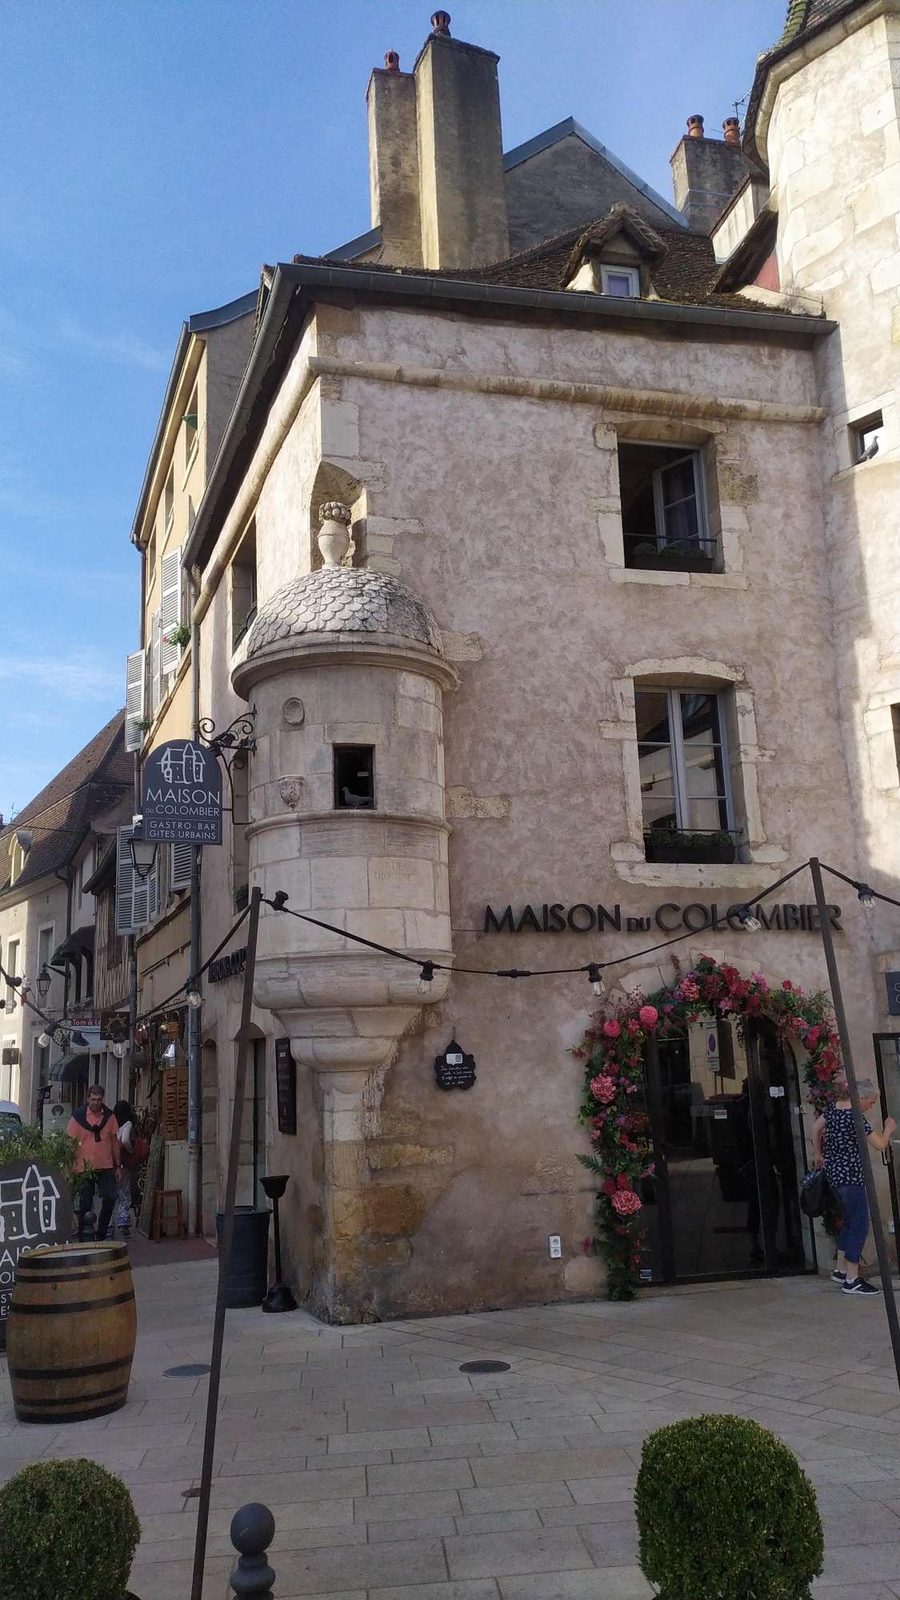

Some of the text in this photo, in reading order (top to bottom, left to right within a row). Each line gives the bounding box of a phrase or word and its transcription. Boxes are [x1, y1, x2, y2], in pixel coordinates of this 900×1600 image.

[146, 787, 220, 804] MAISON
[155, 805, 220, 816] COLOMBIER
[149, 829, 216, 840] GITES URBAINS
[484, 903, 622, 933] MAISON
[626, 917, 651, 932] DU
[165, 1074, 177, 1134] CHOCOLAT
